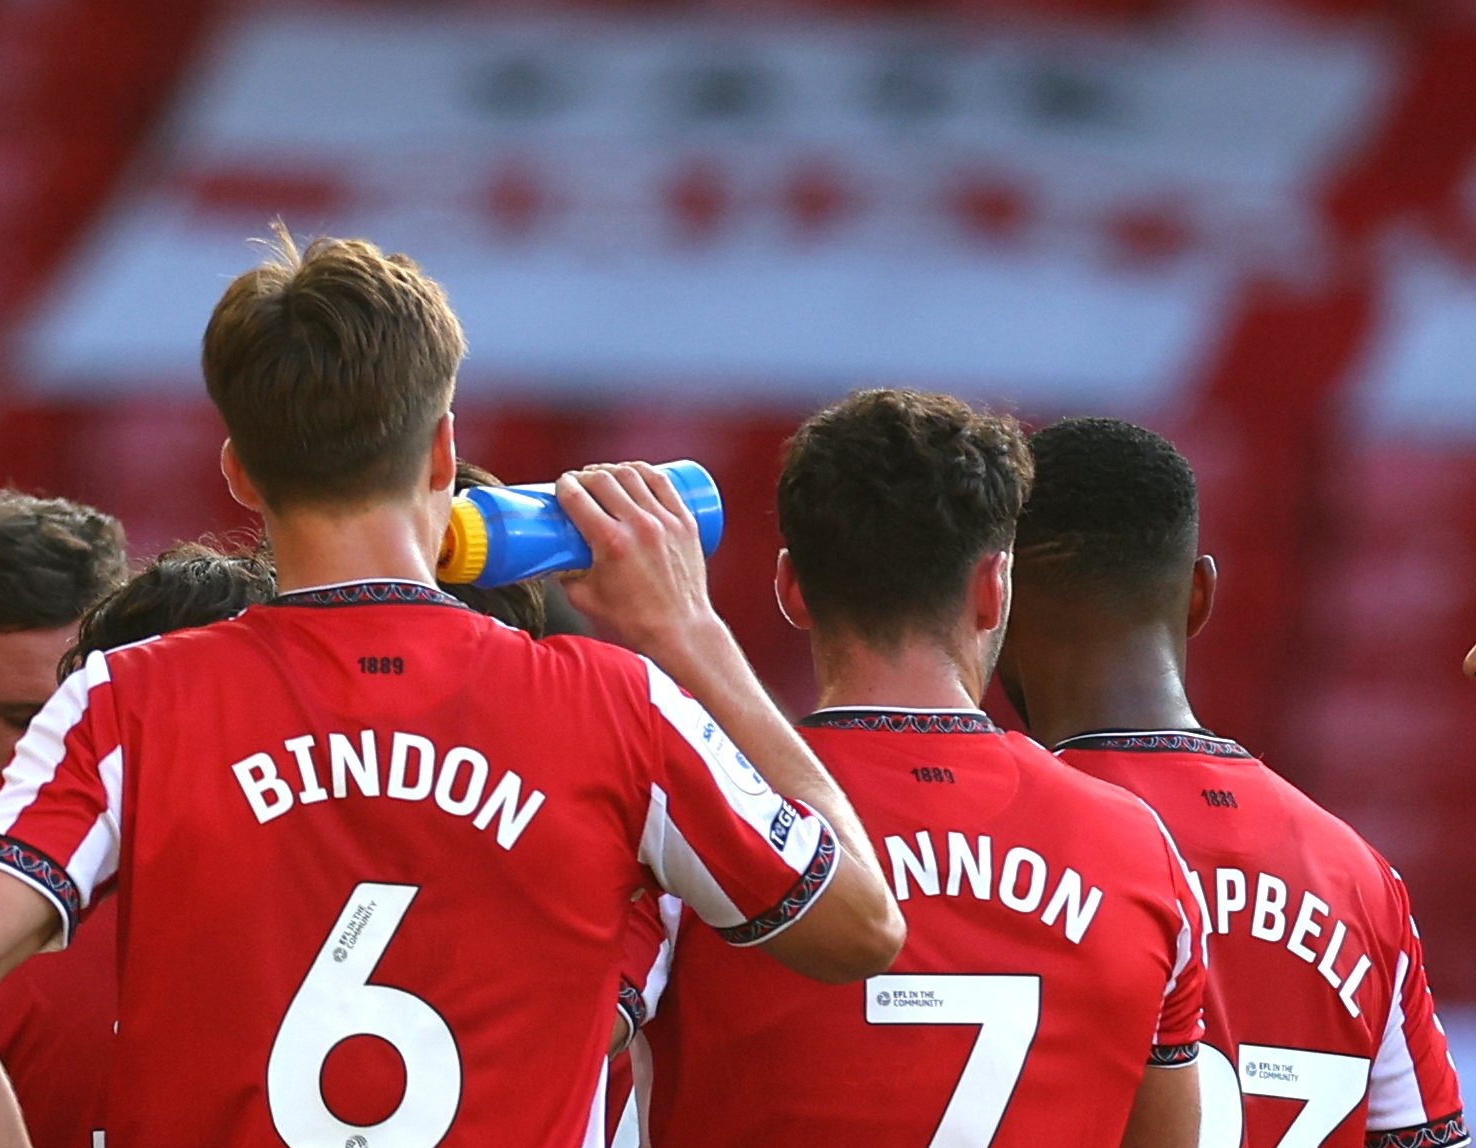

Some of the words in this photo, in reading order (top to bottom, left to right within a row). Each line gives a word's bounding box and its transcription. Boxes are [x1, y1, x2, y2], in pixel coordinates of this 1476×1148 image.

[358, 657, 404, 675] 1889
[911, 767, 955, 784] 1889
[231, 729, 546, 851] BINDON
[893, 990, 907, 999] EFL
[893, 999, 944, 1008] COMMUNITY
